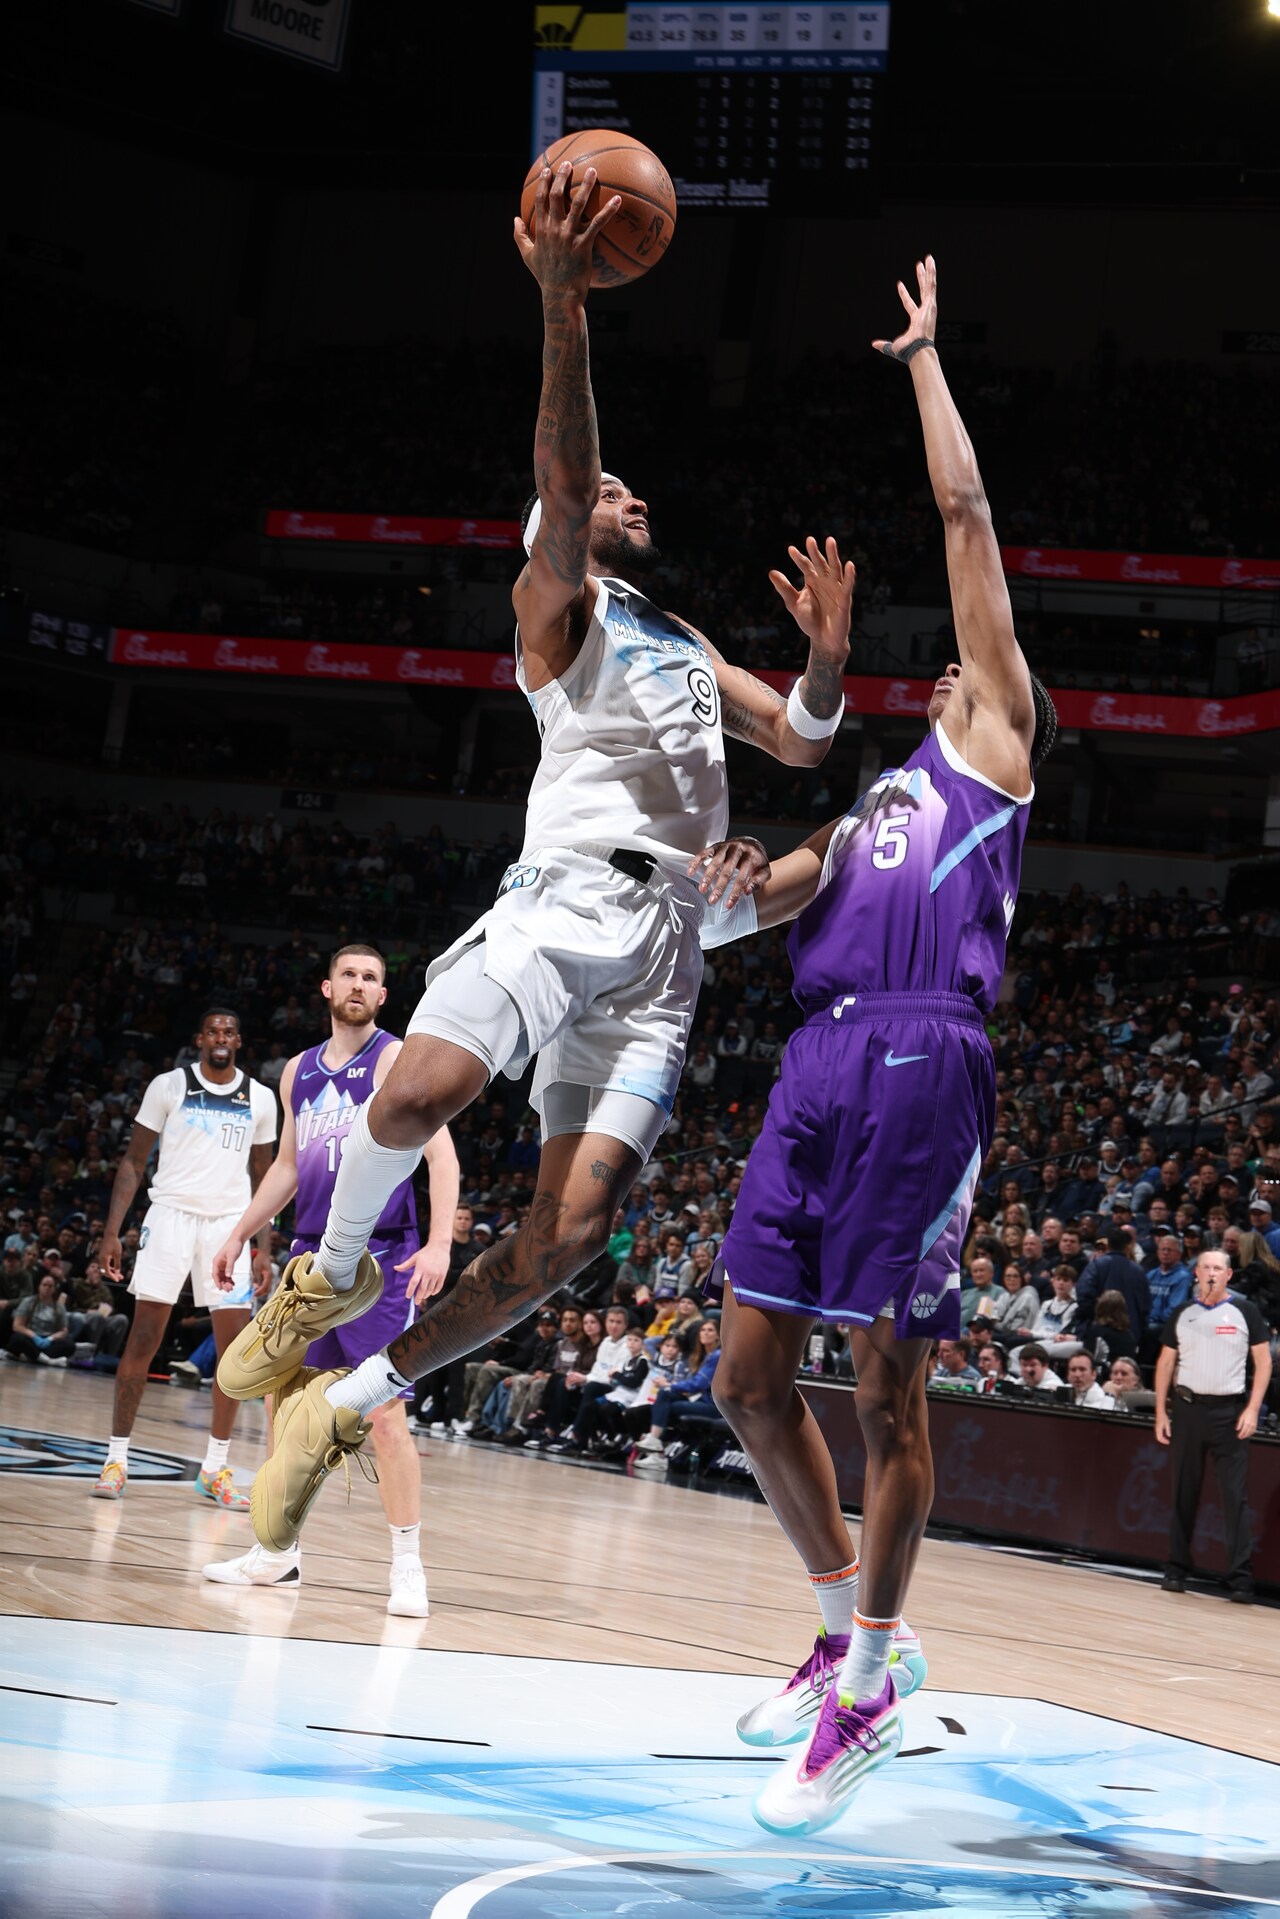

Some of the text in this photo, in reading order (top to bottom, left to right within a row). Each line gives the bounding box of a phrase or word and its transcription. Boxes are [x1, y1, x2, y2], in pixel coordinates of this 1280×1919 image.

[250, 0, 324, 41] MOORE
[729, 30, 746, 42] 35
[720, 77, 731, 90] 3
[770, 77, 781, 90] 3
[769, 96, 780, 109] 2
[767, 136, 779, 149] 3
[687, 668, 718, 728] 9
[871, 813, 911, 871] 5
[346, 1067, 367, 1078] LVT
[186, 1107, 247, 1122] MINNESOTA
[297, 1104, 361, 1152] UTAH
[222, 1123, 246, 1152] 11
